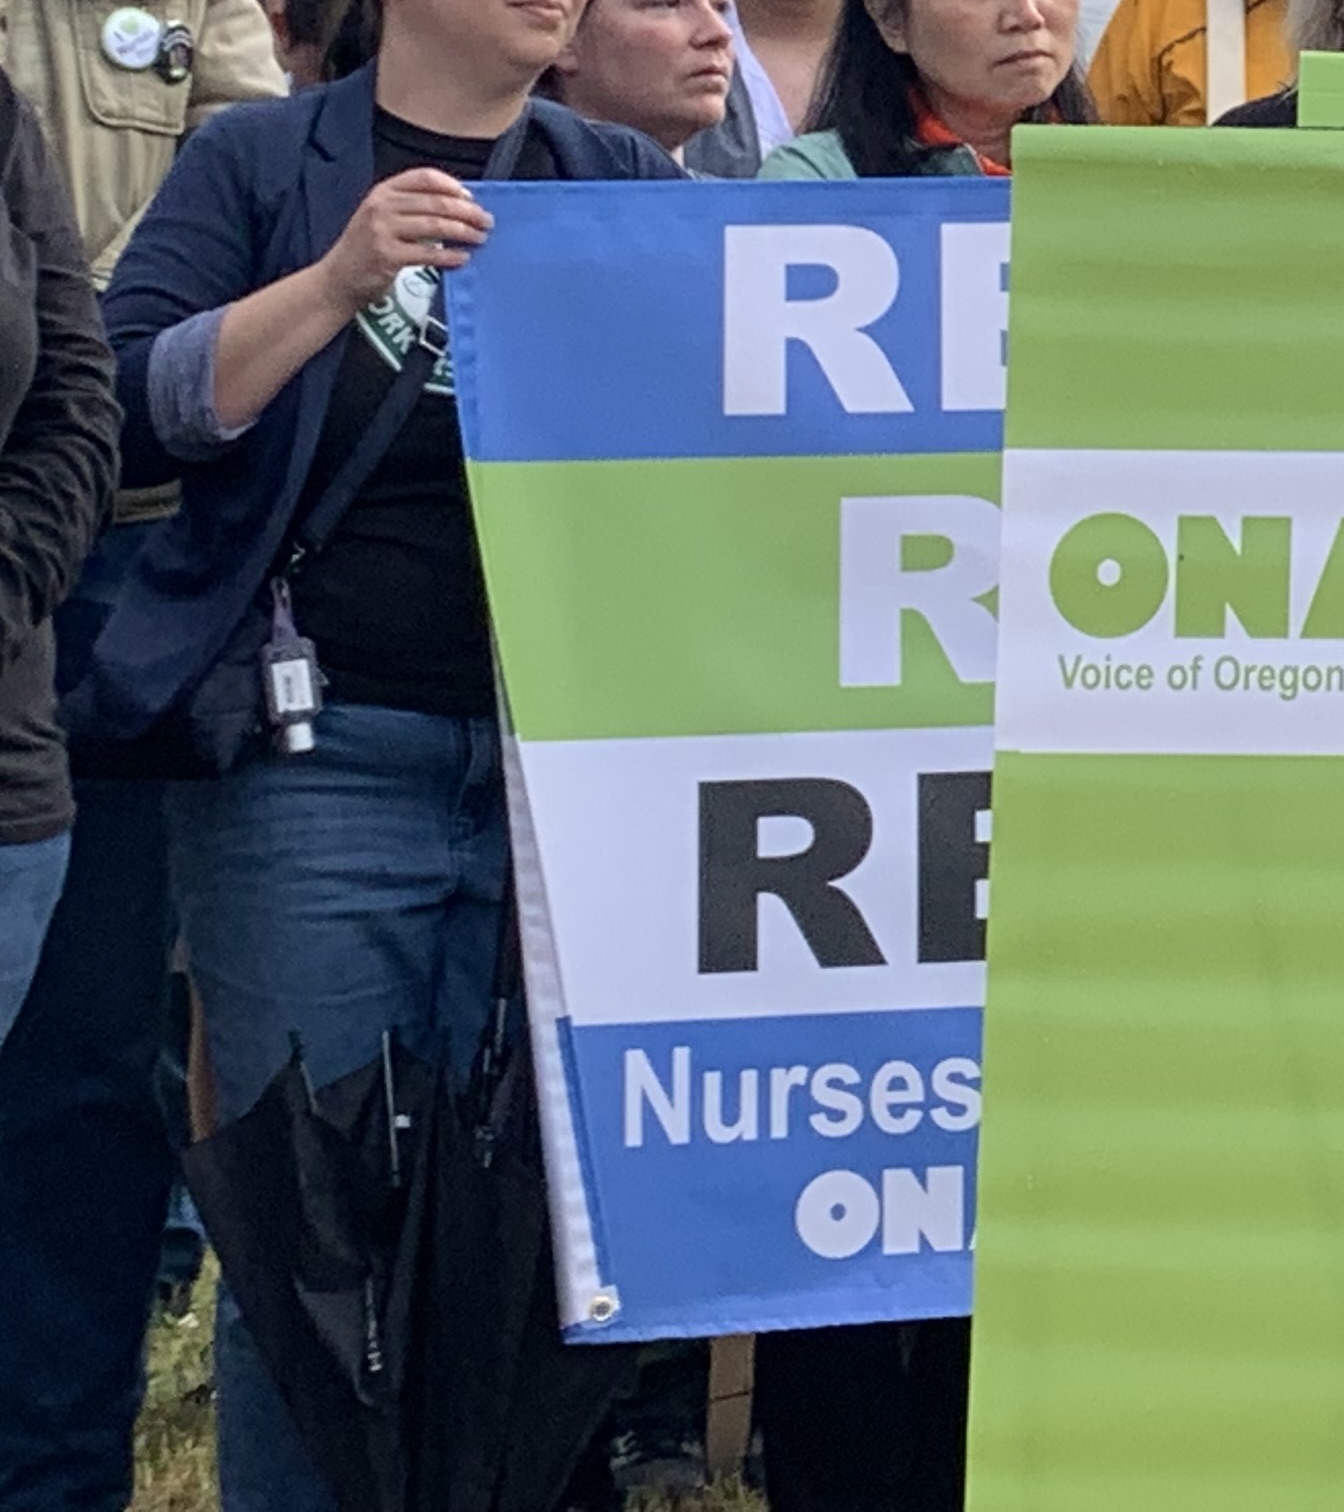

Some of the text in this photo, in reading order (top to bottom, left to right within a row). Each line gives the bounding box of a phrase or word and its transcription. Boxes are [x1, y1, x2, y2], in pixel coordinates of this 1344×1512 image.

[1057, 654, 1155, 691] Voice
[1166, 654, 1205, 691] of
[1213, 655, 1344, 701] Oregon
[623, 1045, 982, 1148] Nurses
[795, 1165, 978, 1259] ON
